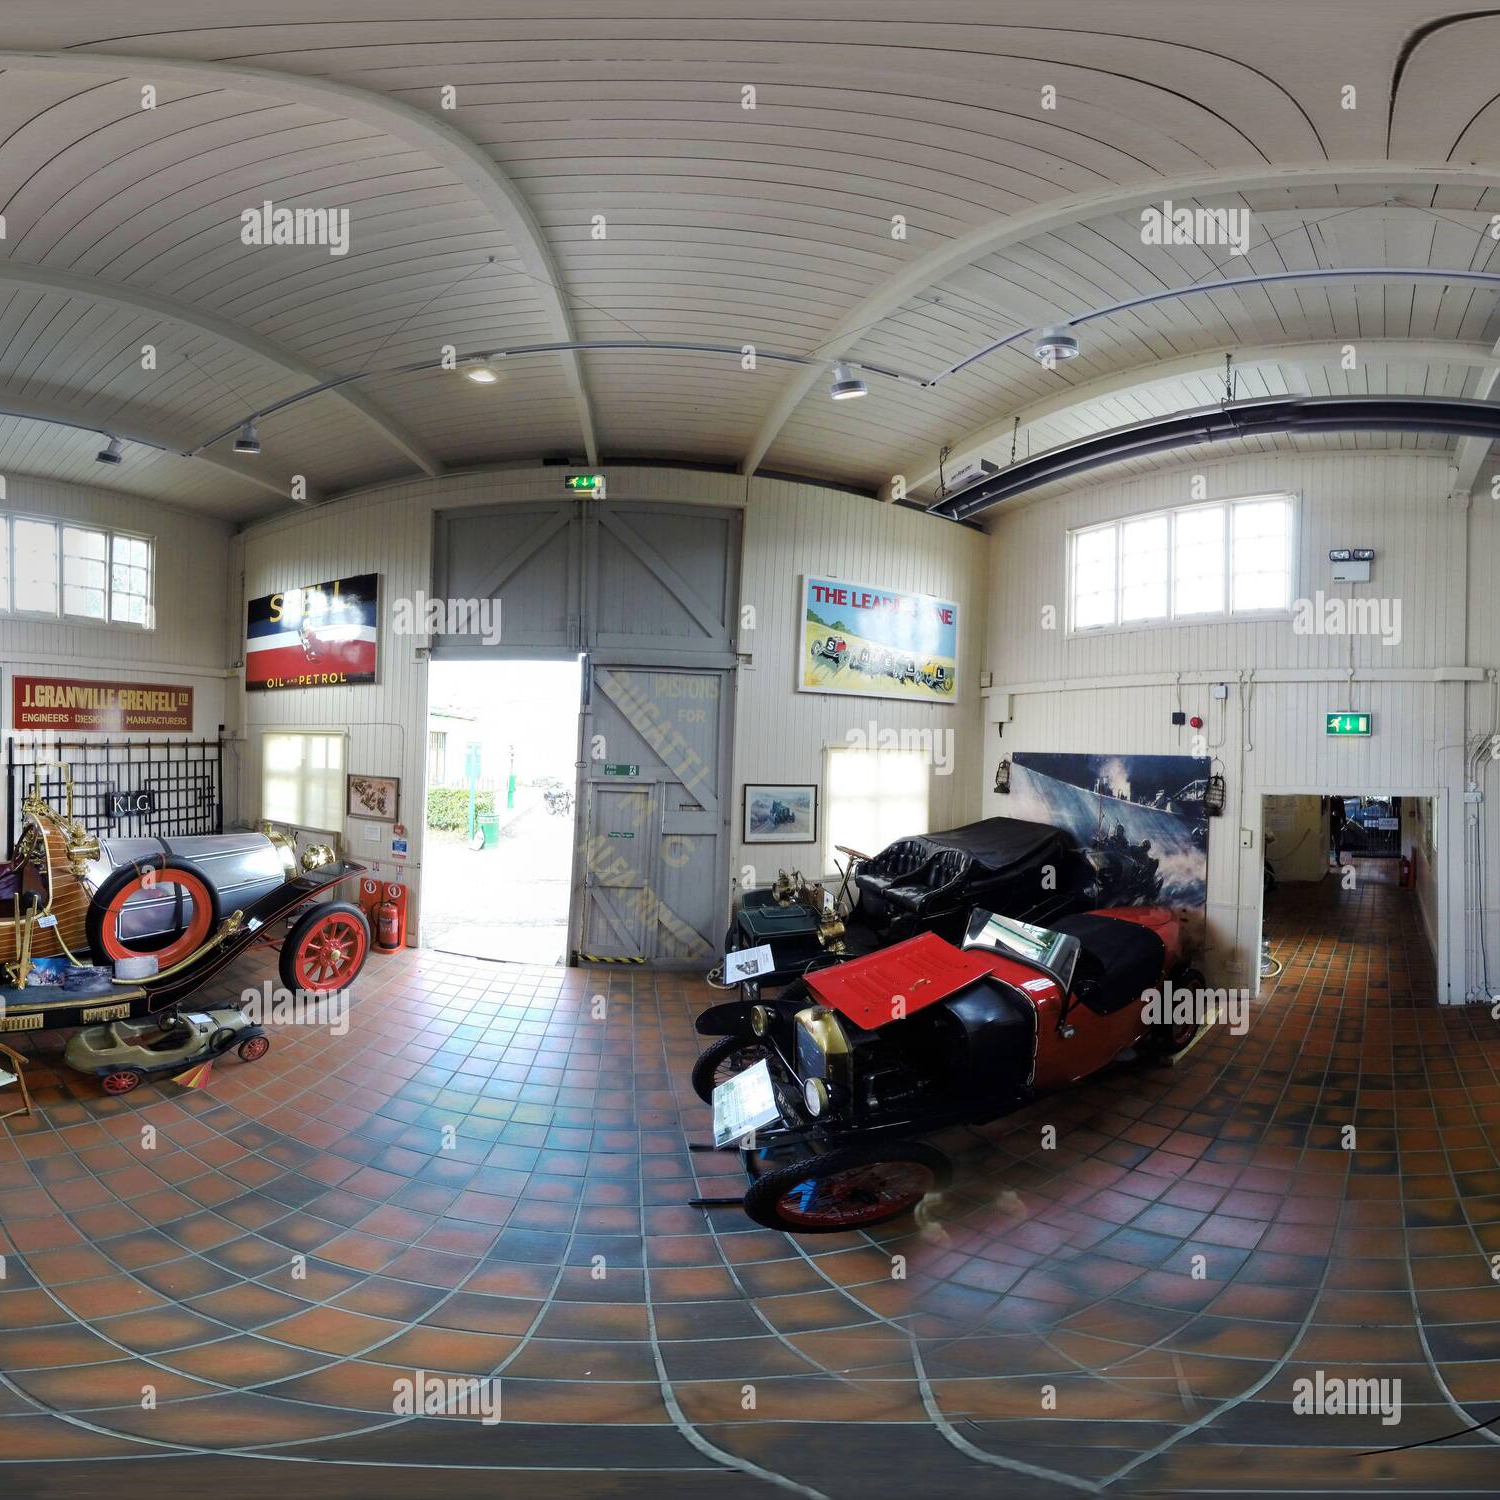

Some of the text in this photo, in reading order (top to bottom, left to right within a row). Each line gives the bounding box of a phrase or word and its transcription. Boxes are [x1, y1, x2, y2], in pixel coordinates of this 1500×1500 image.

[812, 585, 848, 606] THE
[266, 678, 285, 689] OIL
[299, 672, 347, 686] PETROL
[117, 689, 178, 712] GRENFELL
[22, 713, 69, 723] ENGINEERS
[126, 717, 187, 725] MANUFACTURERS
[677, 709, 706, 722] FOR
